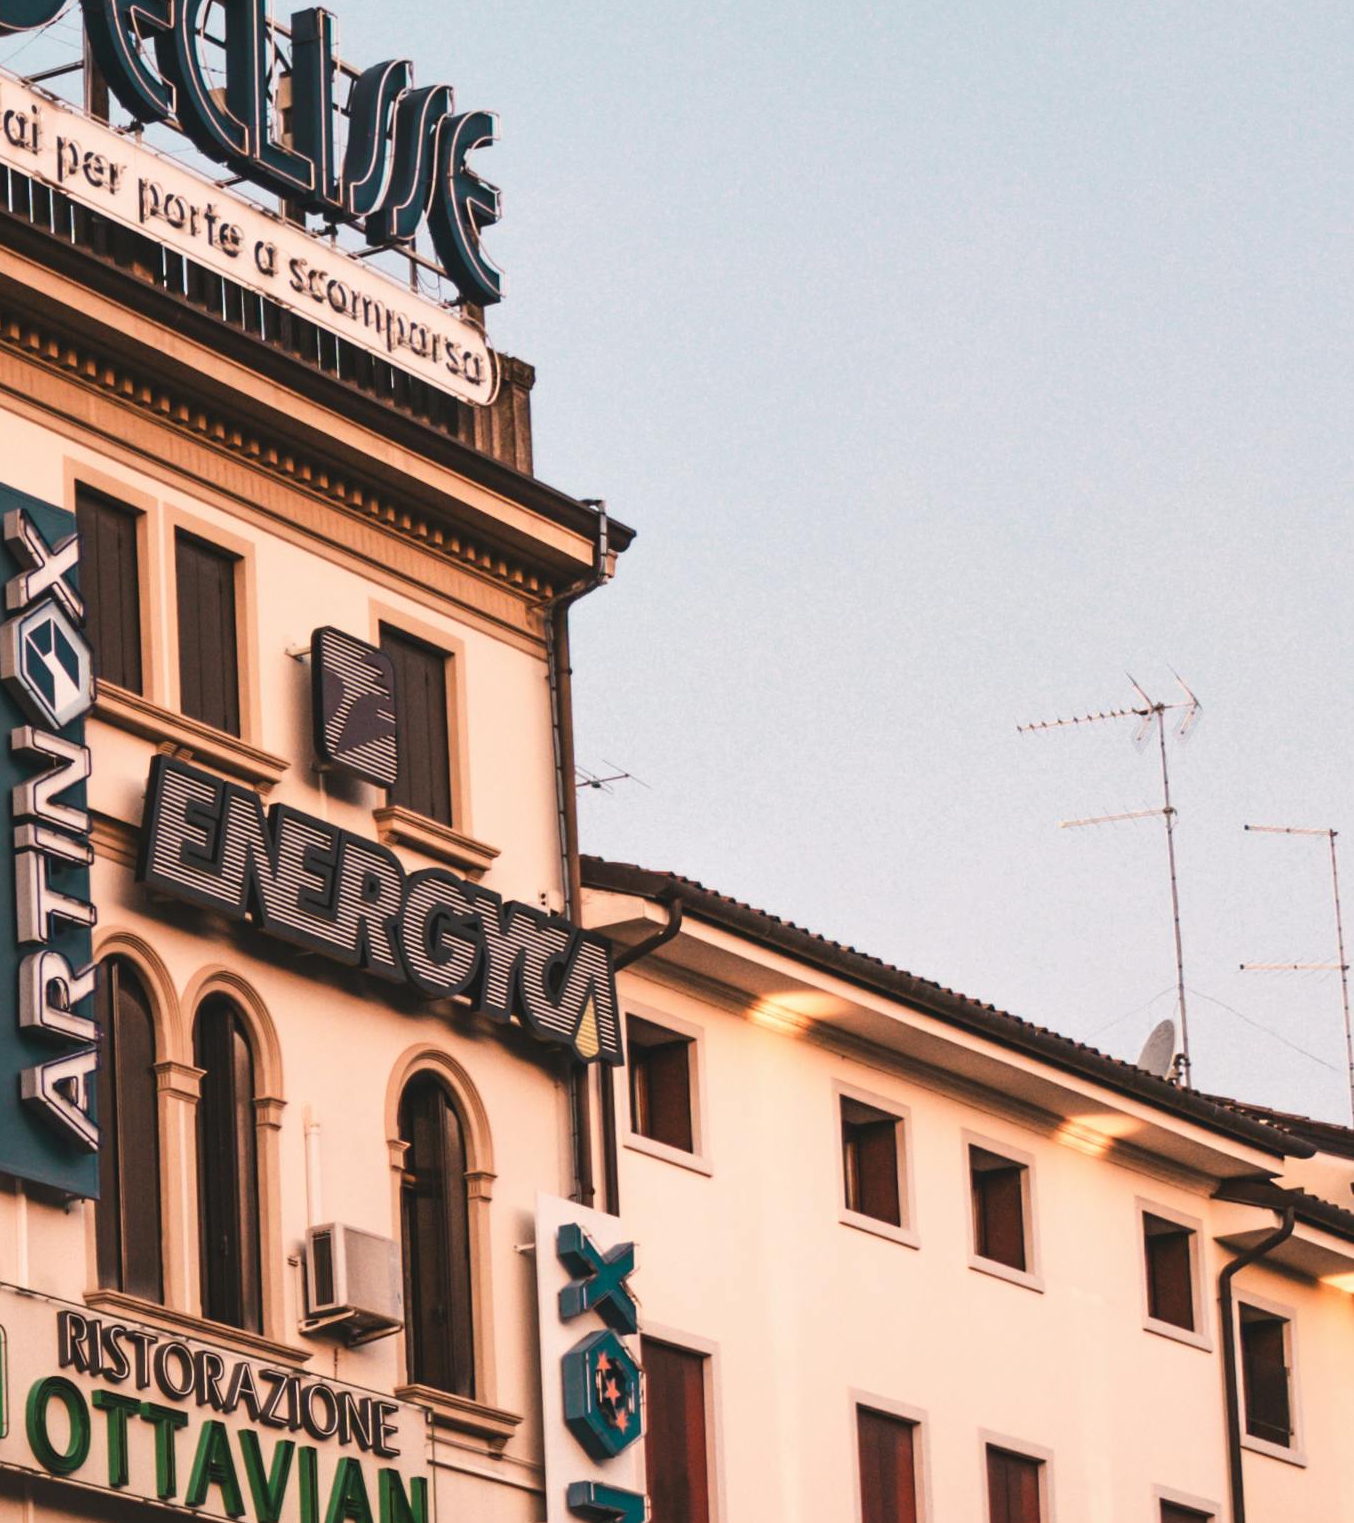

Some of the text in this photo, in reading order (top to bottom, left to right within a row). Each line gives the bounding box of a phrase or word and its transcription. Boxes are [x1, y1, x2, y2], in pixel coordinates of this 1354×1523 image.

[56, 134, 127, 197] per
[138, 176, 245, 258] porte
[254, 238, 279, 279] a
[288, 256, 487, 387] scomparsa
[0, 507, 100, 1154] ARTINOX
[56, 1309, 401, 1458] RISTORAZIONE
